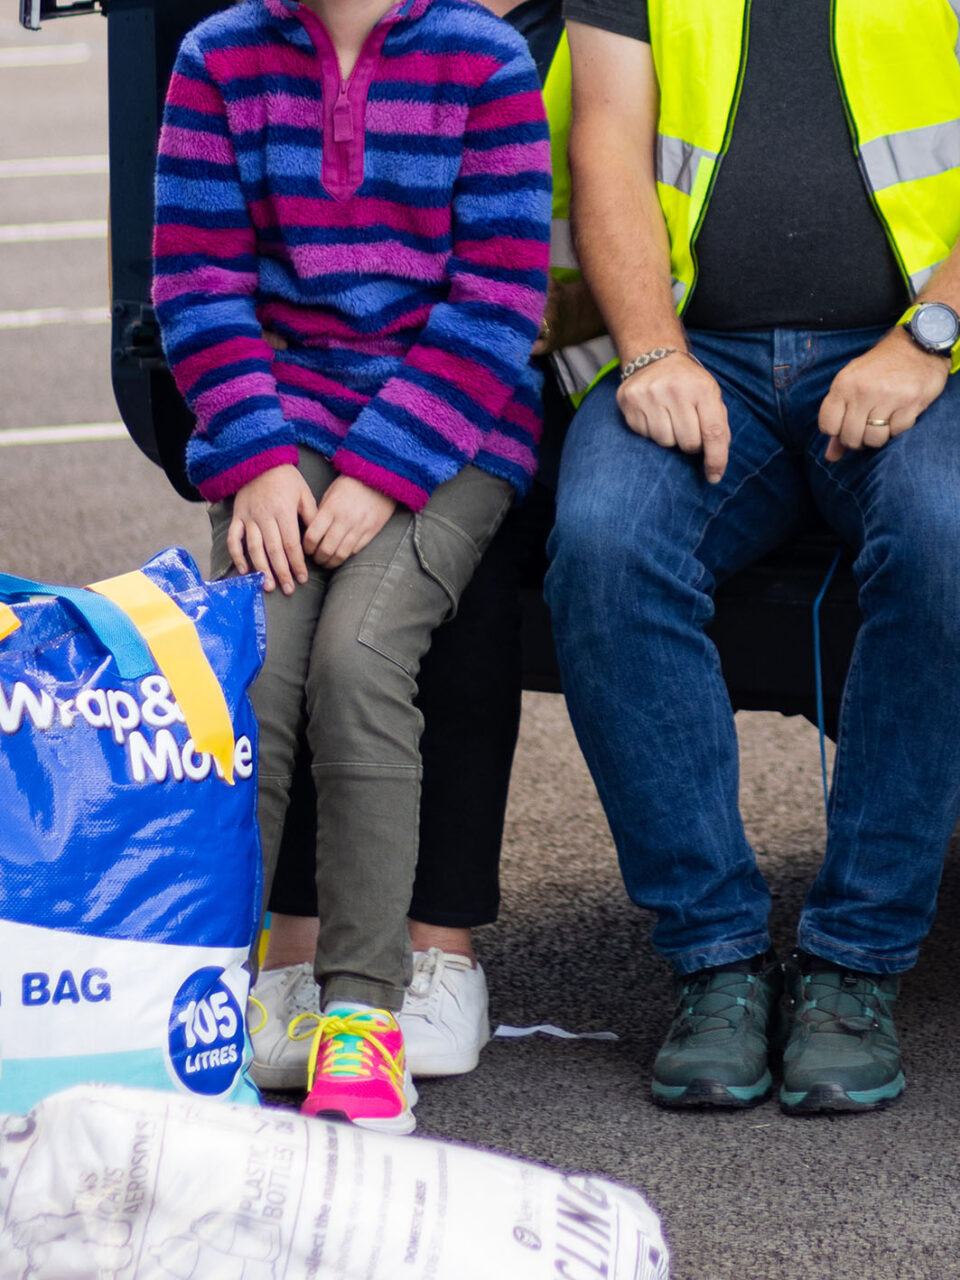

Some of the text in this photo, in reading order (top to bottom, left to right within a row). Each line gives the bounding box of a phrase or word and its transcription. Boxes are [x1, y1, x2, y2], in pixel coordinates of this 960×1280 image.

[129, 728, 253, 783] Moe
[21, 967, 112, 1007] BAG
[178, 991, 238, 1048] 105
[185, 1043, 238, 1074] LITRES
[261, 1144, 294, 1220] BOTTLES
